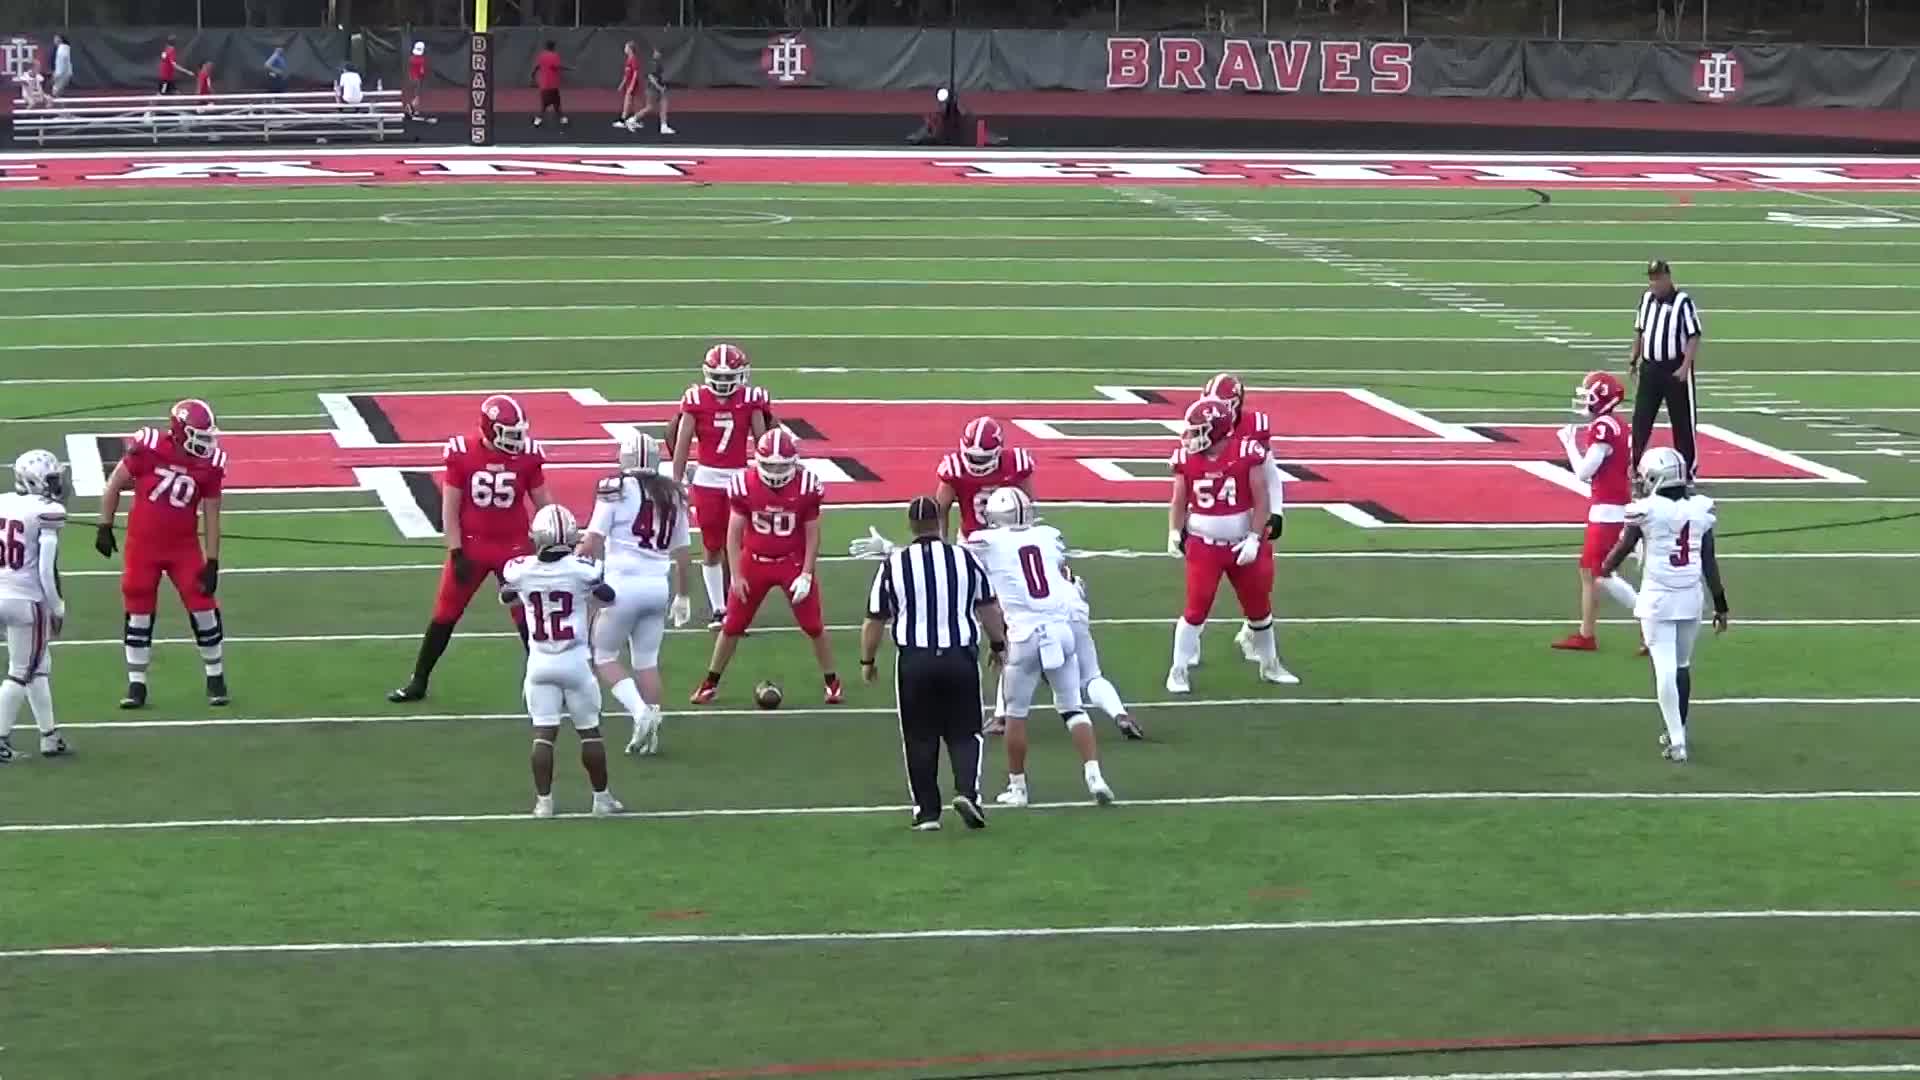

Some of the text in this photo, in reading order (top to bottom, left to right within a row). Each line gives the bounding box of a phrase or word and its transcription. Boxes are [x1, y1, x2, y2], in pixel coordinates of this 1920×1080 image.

[1106, 37, 1414, 94] BRAVES
[471, 35, 487, 144] BRAVES
[0, 159, 698, 181] AN
[713, 419, 734, 454] 7
[148, 466, 196, 508] 70
[471, 470, 517, 509] 65
[1193, 476, 1237, 509] 54
[1018, 544, 1050, 599] 0
[529, 590, 575, 641] 12
